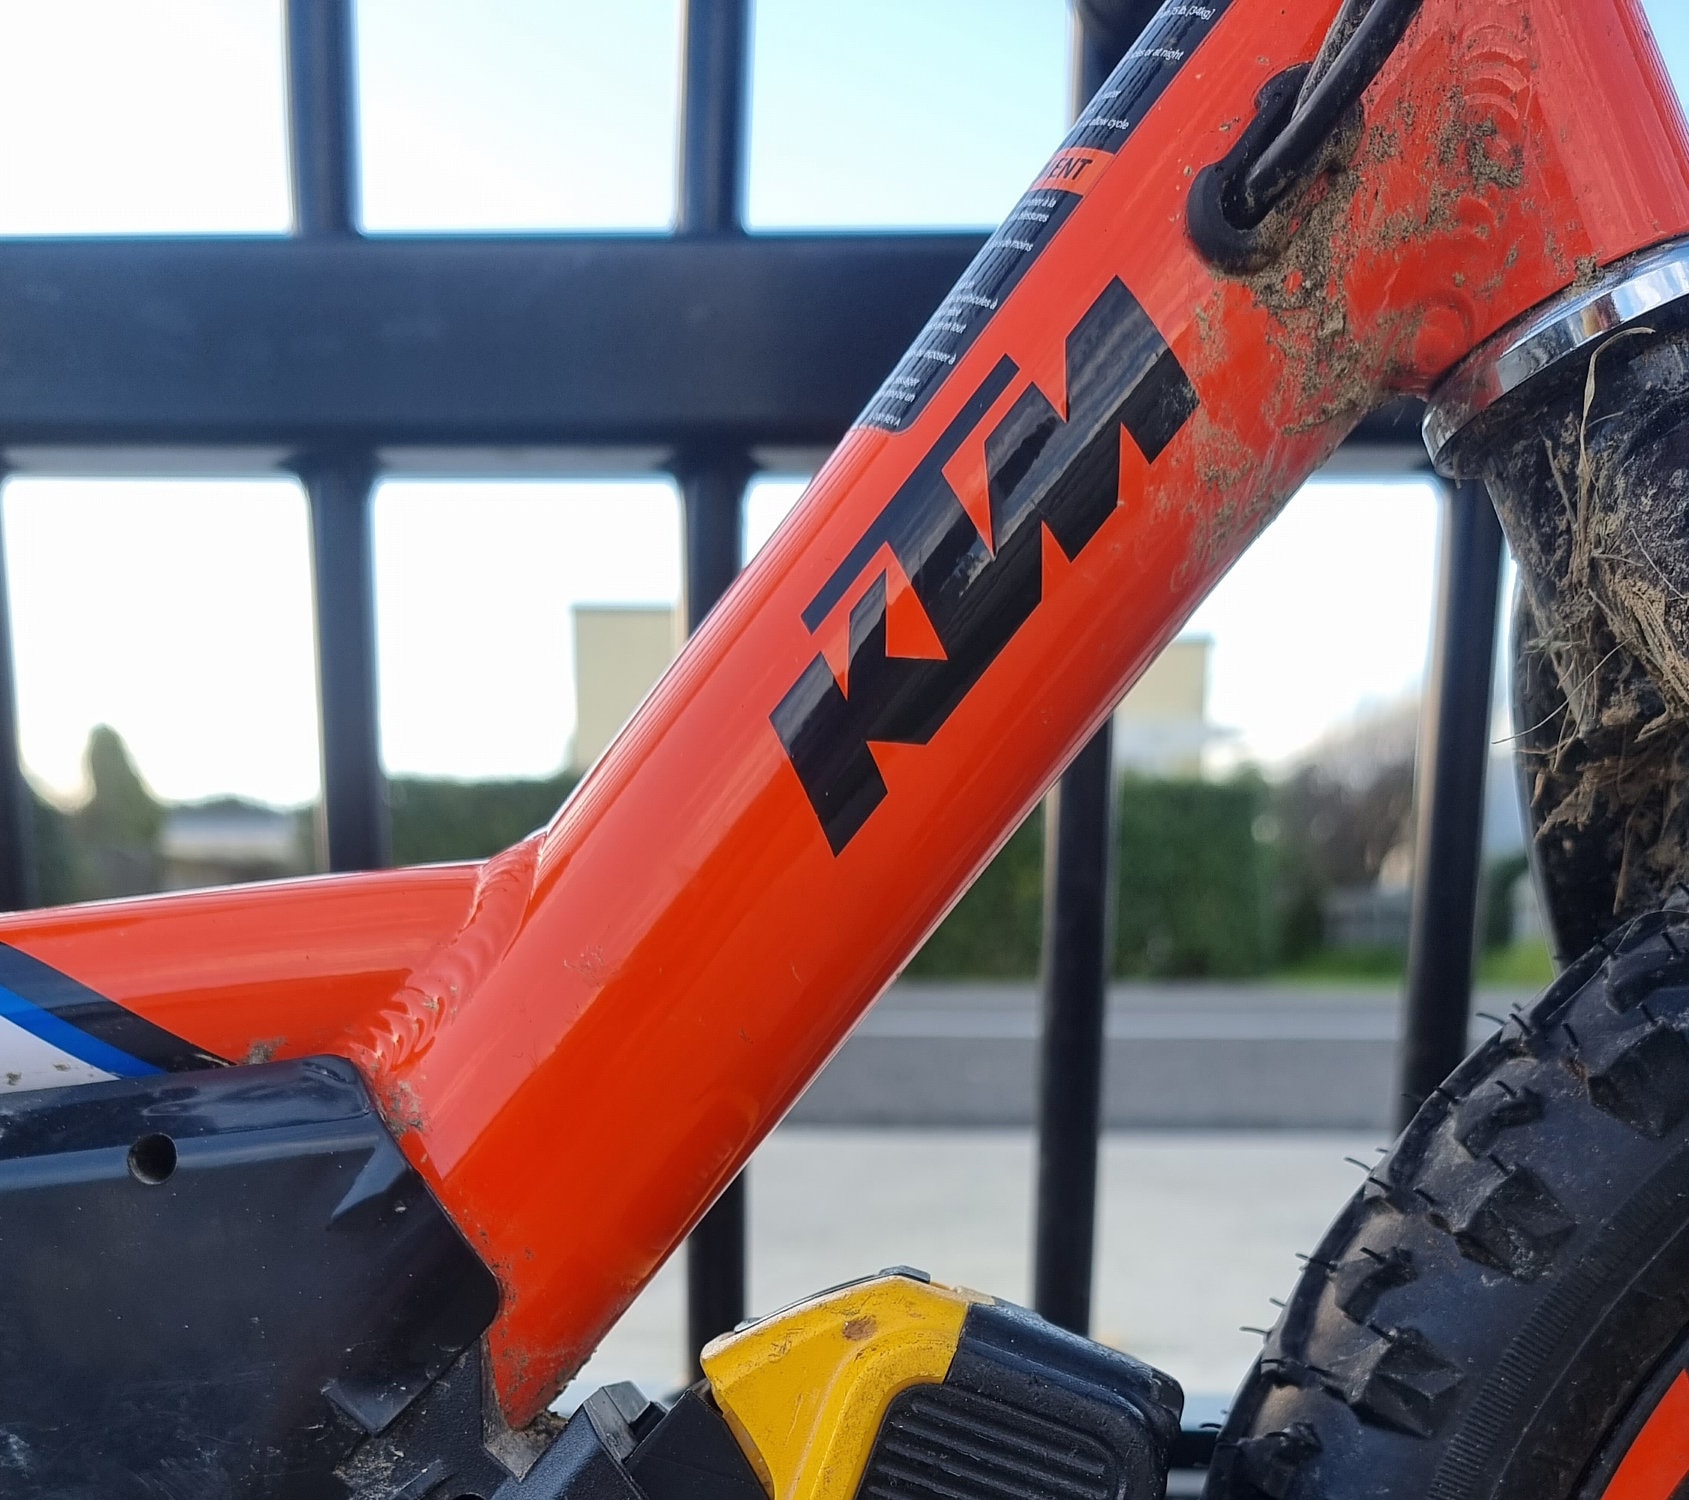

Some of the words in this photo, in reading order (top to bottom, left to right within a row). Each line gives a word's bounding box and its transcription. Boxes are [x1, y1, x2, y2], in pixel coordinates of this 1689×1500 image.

[1160, 47, 1184, 60] night
[1107, 119, 1130, 130] cycle
[1043, 157, 1093, 180] ENT
[769, 274, 1200, 858] KTM
